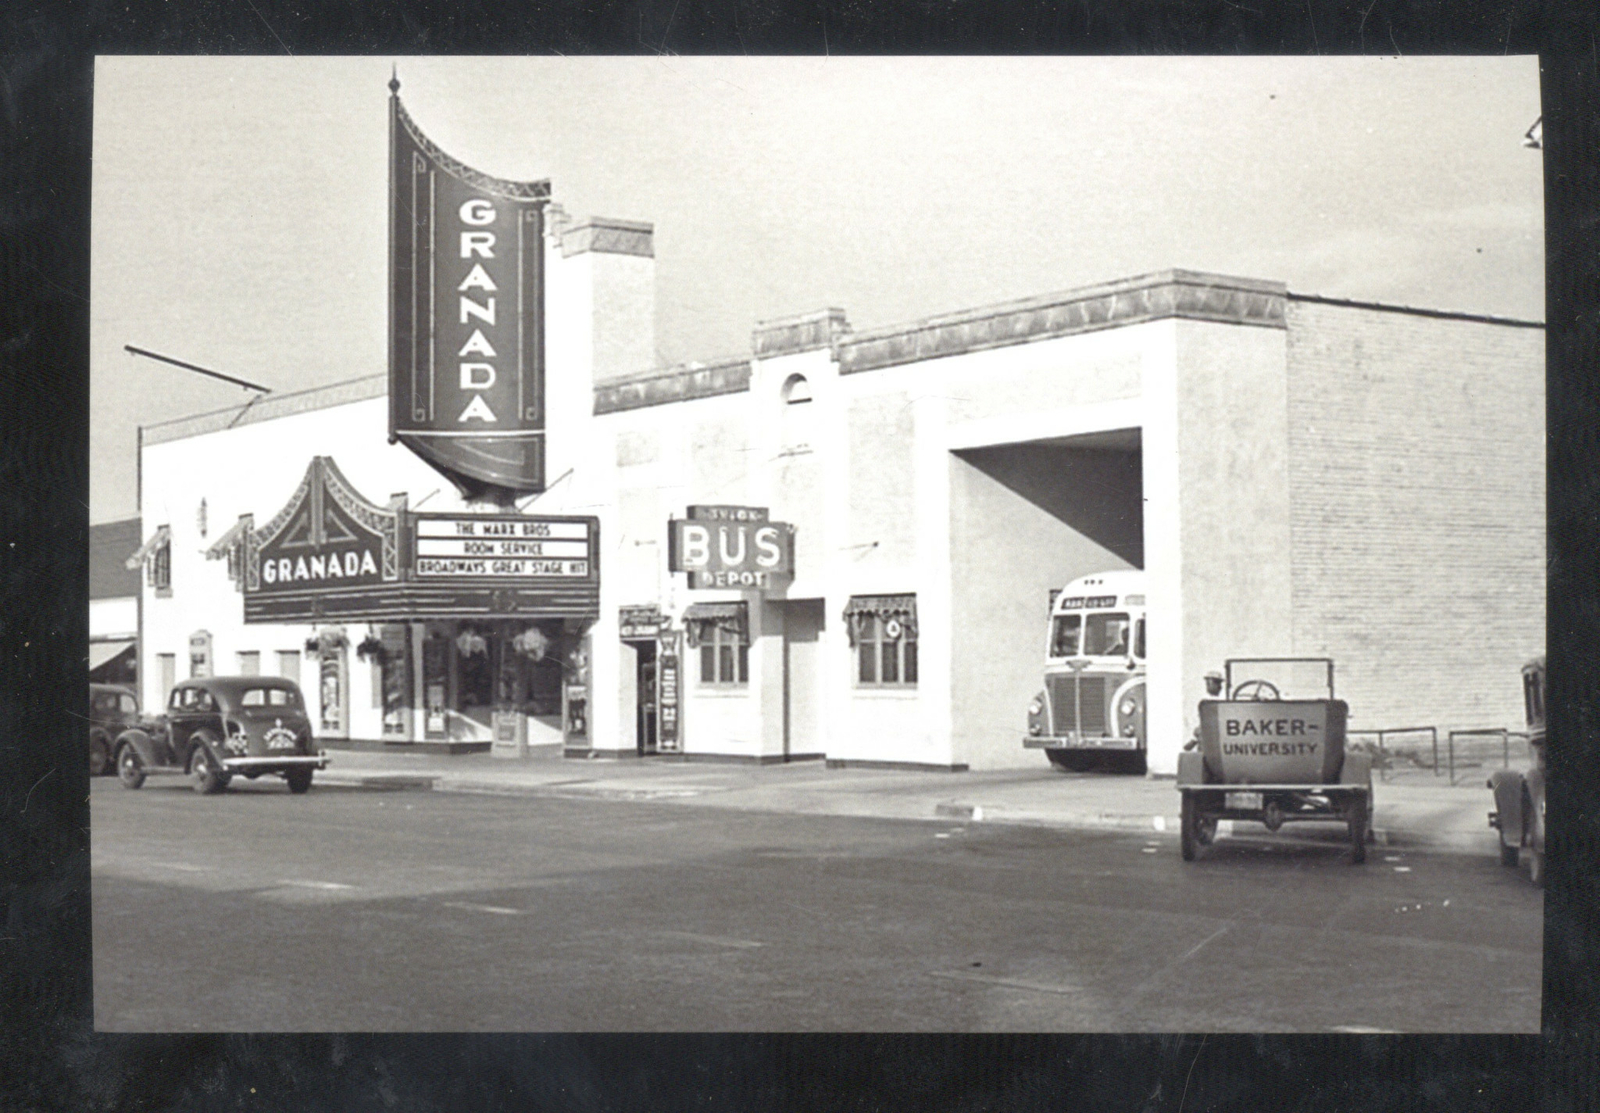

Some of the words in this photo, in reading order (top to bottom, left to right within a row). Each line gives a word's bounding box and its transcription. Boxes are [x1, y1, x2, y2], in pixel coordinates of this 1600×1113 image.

[458, 199, 498, 422] GRANADA
[455, 522, 475, 535] THE
[483, 523, 516, 535] MARX
[523, 524, 550, 536] BROS
[464, 542, 494, 554] ROOM
[501, 542, 543, 555] SERVICE
[683, 525, 780, 567] BUS
[263, 550, 377, 583] GRANADA
[419, 561, 486, 573] BROADWAYS
[492, 561, 526, 573] GREAT
[532, 562, 563, 574] STAGE
[569, 562, 586, 574] HIT
[701, 571, 764, 587] DEPOT
[1223, 742, 1317, 755] UNIVERSITY
